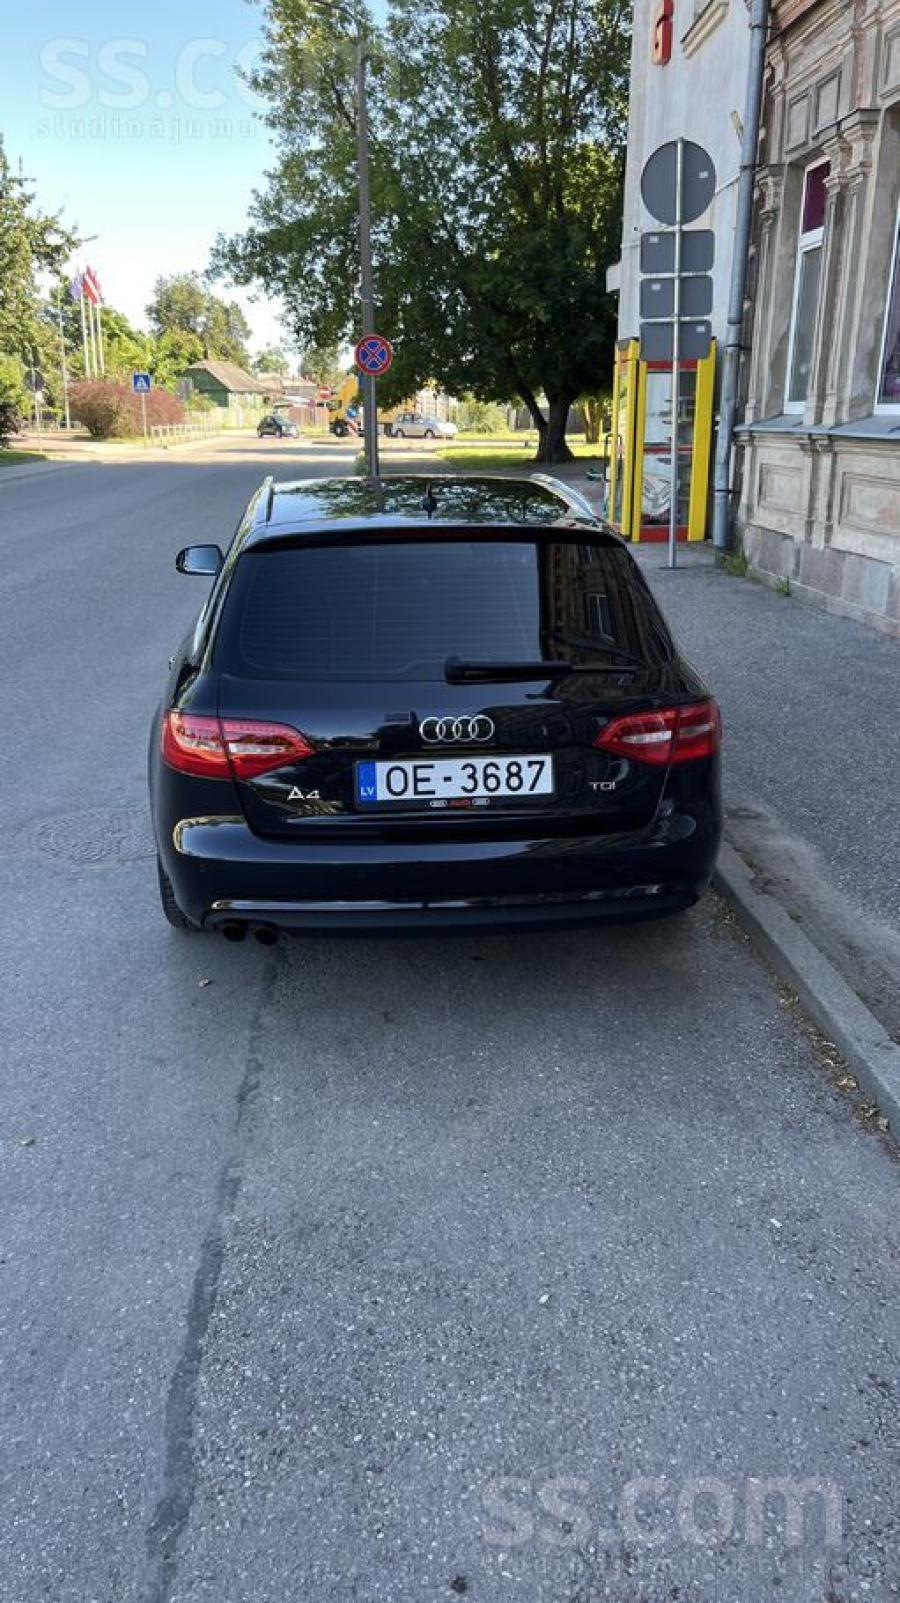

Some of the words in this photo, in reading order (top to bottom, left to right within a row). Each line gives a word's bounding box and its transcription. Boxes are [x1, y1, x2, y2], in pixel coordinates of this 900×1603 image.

[386, 759, 547, 797] OE-3687
[286, 785, 320, 801] A4
[360, 786, 375, 797] LV
